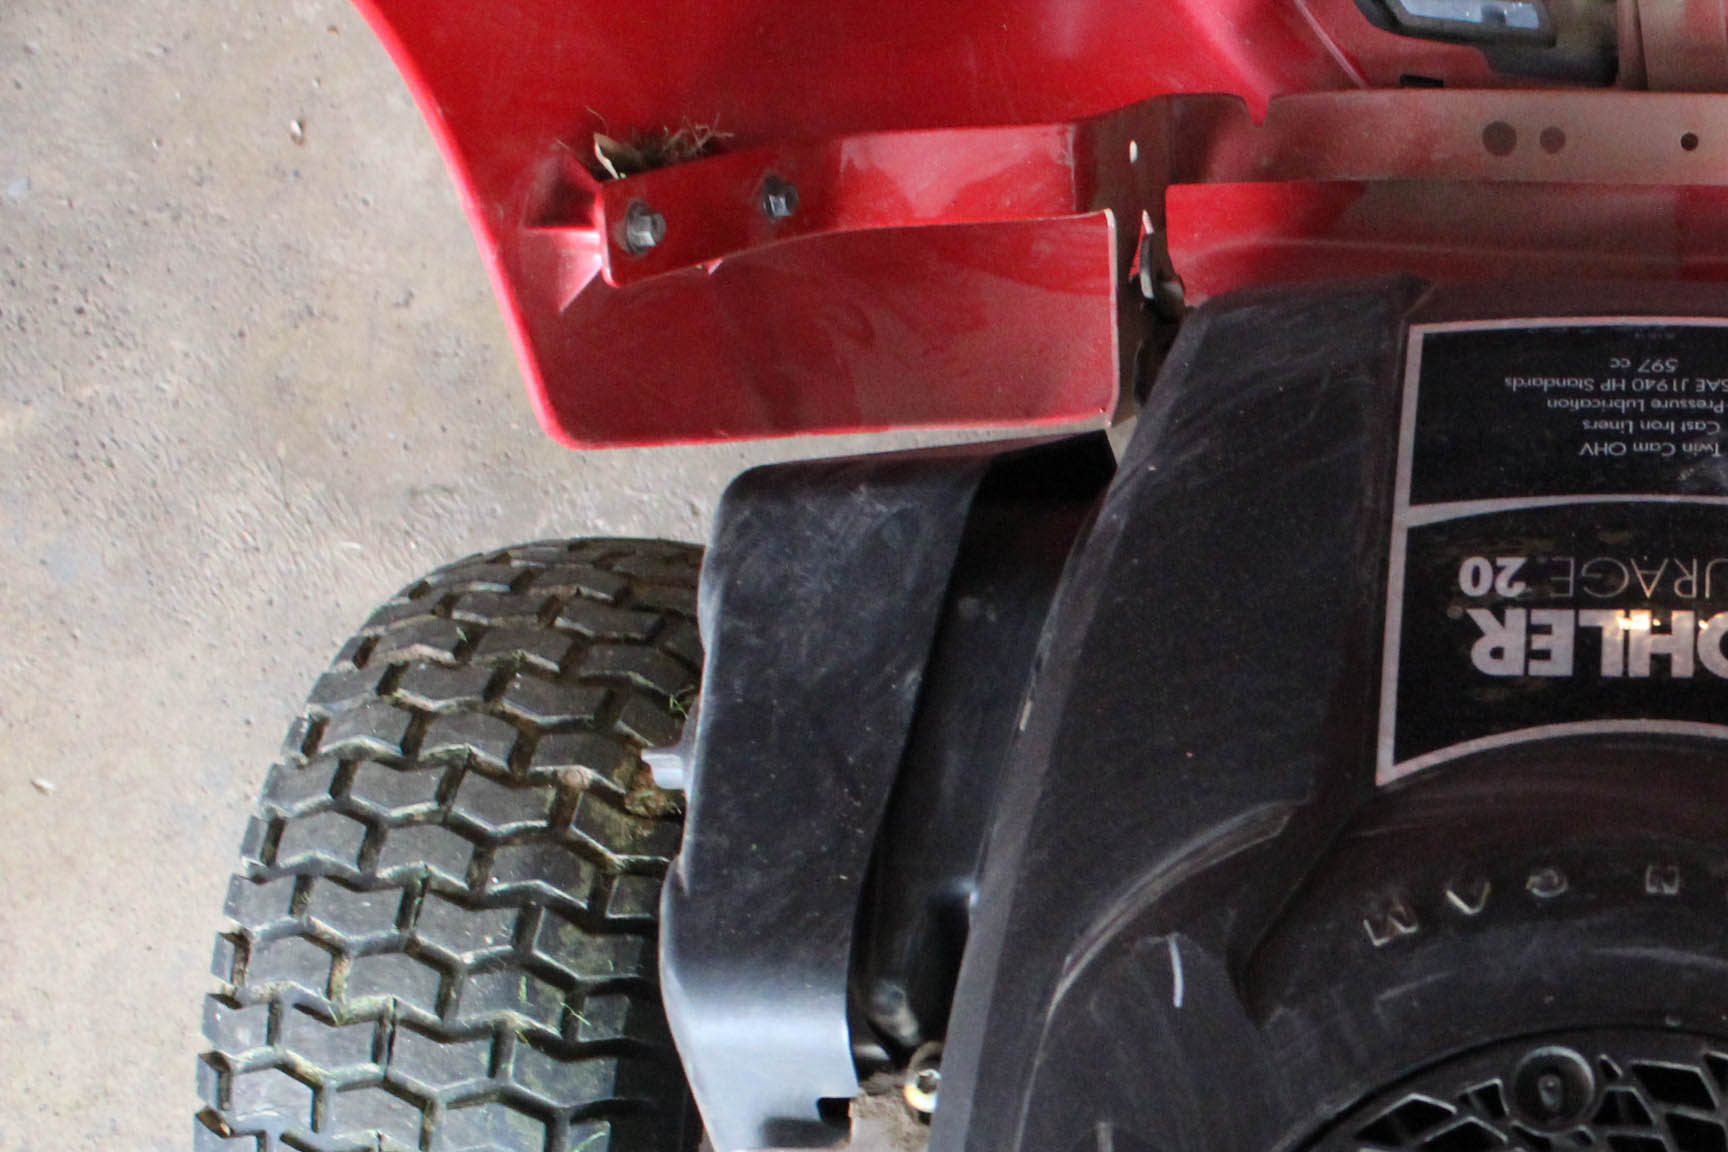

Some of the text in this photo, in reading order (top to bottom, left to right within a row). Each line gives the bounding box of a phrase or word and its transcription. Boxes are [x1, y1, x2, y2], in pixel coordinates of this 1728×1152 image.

[1608, 357, 1679, 373] 597 cc
[1505, 377, 1595, 392] Standards
[1599, 377, 1626, 392] HP
[1632, 377, 1689, 392] J1940
[1547, 399, 1644, 414] Lubrication
[1583, 420, 1721, 435] Cast Iron Liners
[1579, 441, 1721, 457] Twin Cam OHV
[1458, 556, 1527, 597] 20
